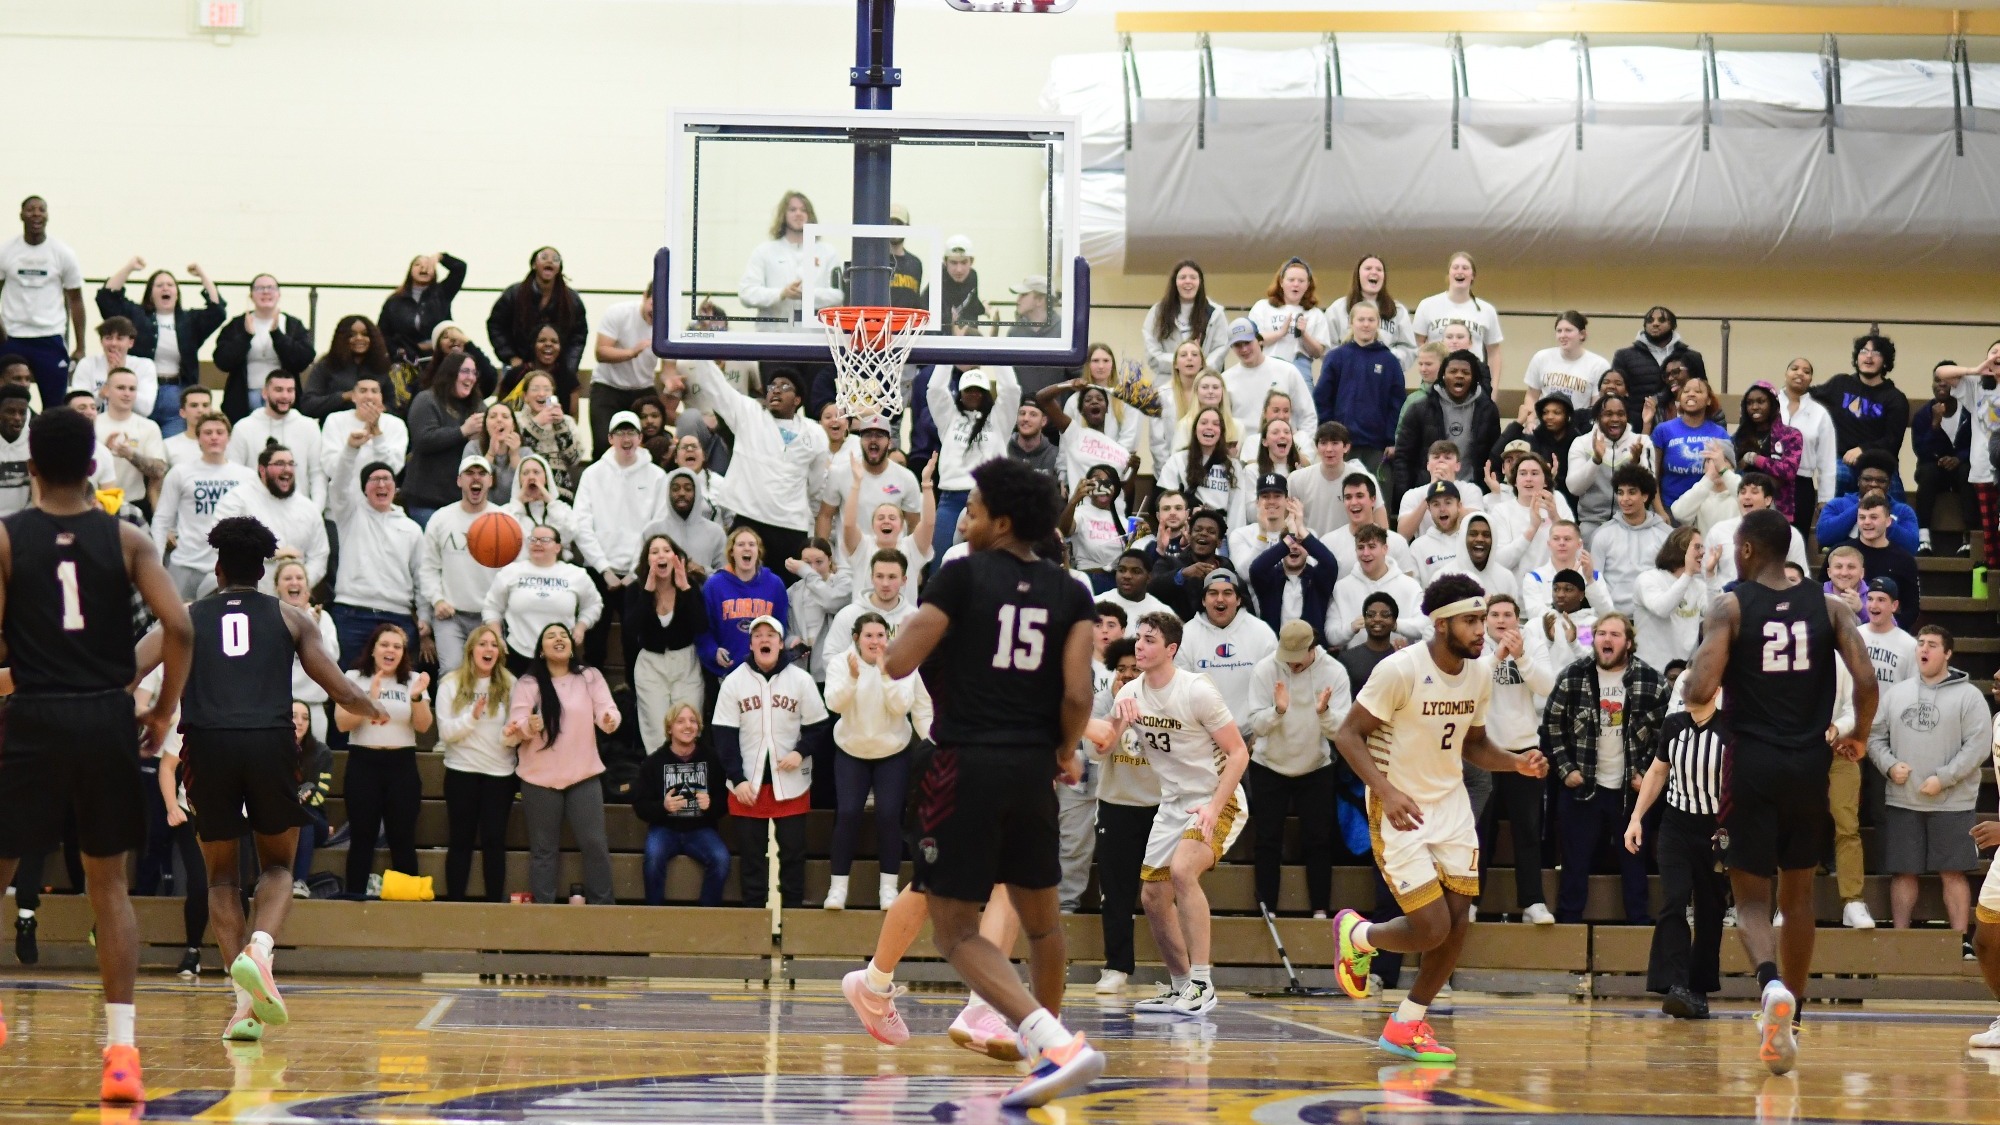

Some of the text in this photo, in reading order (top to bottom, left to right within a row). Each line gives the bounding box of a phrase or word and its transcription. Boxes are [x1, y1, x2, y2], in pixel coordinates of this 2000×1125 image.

[209, 2, 238, 26] EXIT
[1542, 373, 1587, 393] LYCOMING
[518, 576, 569, 588] LYCOMING
[57, 561, 84, 630] 1
[722, 598, 774, 621] FLORIDA
[221, 612, 250, 657] 0
[992, 603, 1049, 671] 15
[1762, 620, 1810, 672] 21
[1197, 659, 1254, 671] Champion
[772, 694, 799, 713] SOX
[1422, 699, 1475, 716] LYCOMING
[1145, 732, 1171, 753] 33
[1441, 722, 1456, 750] 2
